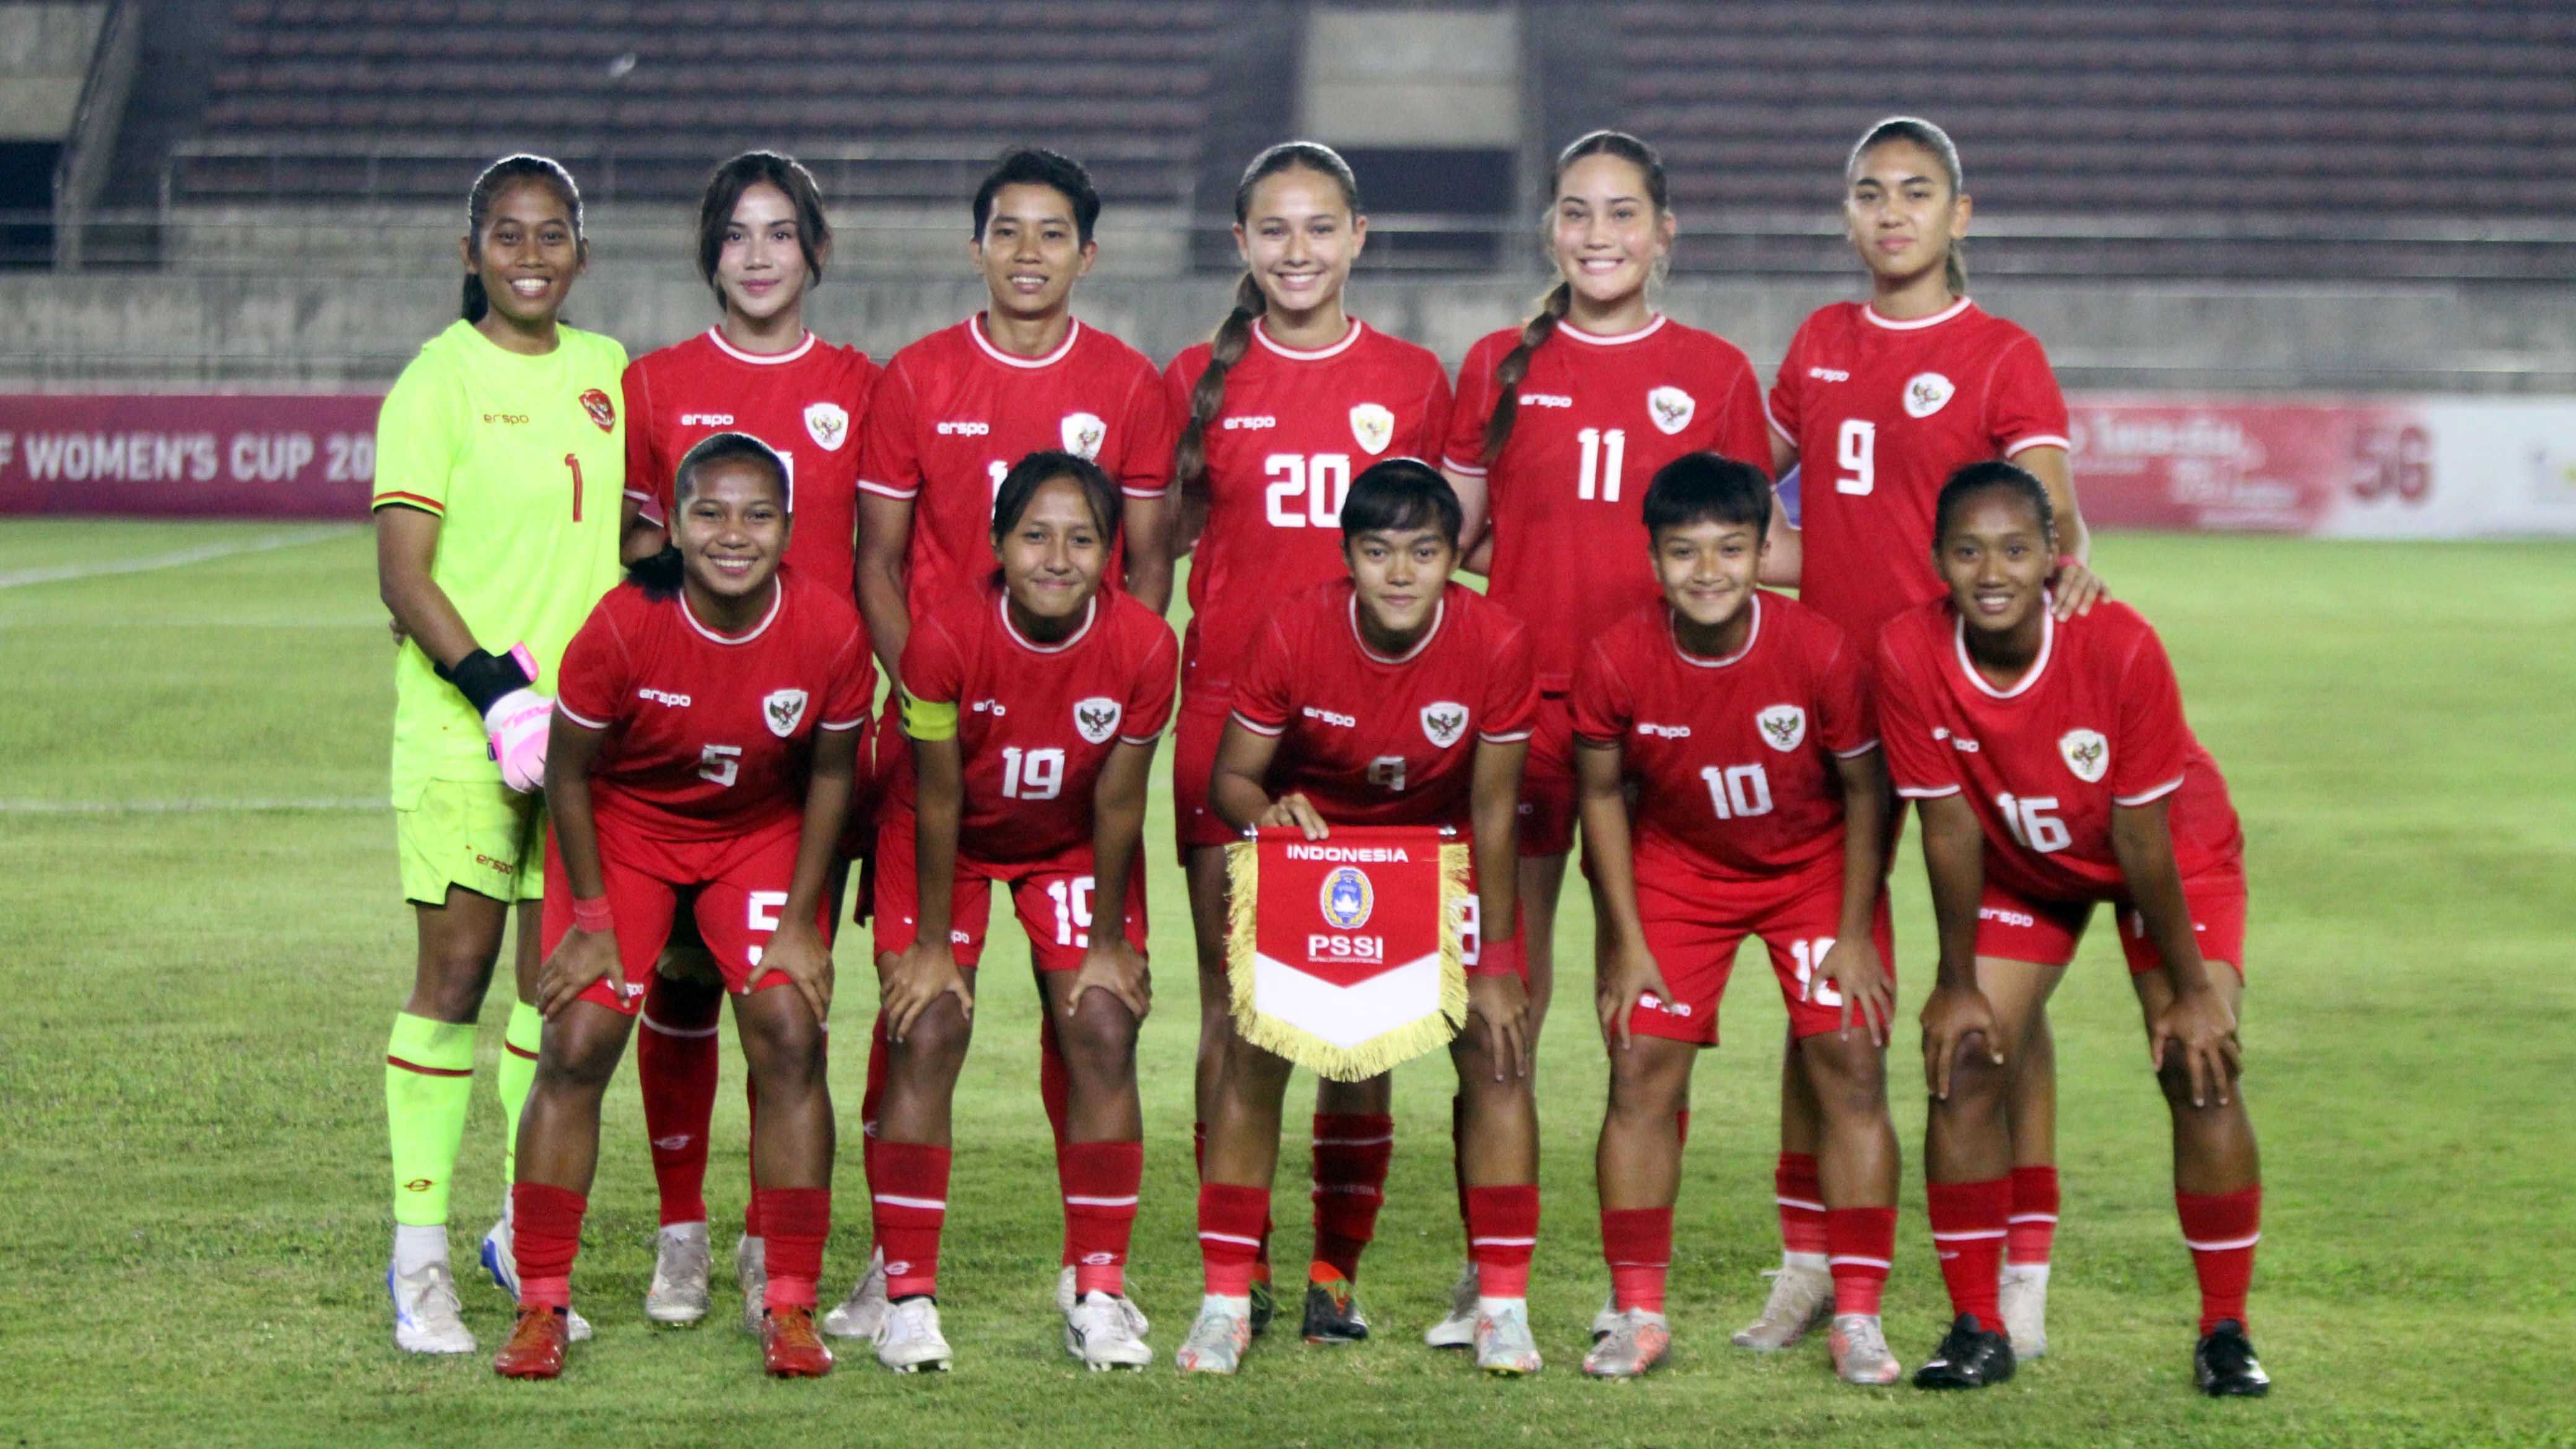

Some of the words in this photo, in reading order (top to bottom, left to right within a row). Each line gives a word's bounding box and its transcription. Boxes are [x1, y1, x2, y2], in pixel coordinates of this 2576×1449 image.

[1519, 394, 1573, 408] erspo
[484, 414, 529, 424] erspo
[682, 414, 734, 427] erspo
[937, 422, 990, 437] erspo
[1223, 416, 1276, 430] erspo
[24, 435, 218, 481] WOMEN'S
[230, 435, 313, 481] CUP
[1578, 428, 1625, 502] 11
[1835, 418, 1876, 496] 9
[564, 453, 583, 522] 1
[1265, 454, 1351, 528] 20
[639, 689, 691, 707] erspo
[1303, 707, 1356, 728] erspo
[1637, 723, 1691, 739] erspo
[698, 744, 742, 787] 5
[1003, 747, 1065, 799] 19
[1701, 763, 1773, 819] 10
[1997, 792, 2073, 853] 16
[476, 853, 513, 874] erspo
[1287, 844, 1409, 863] INDONESIA
[1308, 934, 1383, 959] PSSI
